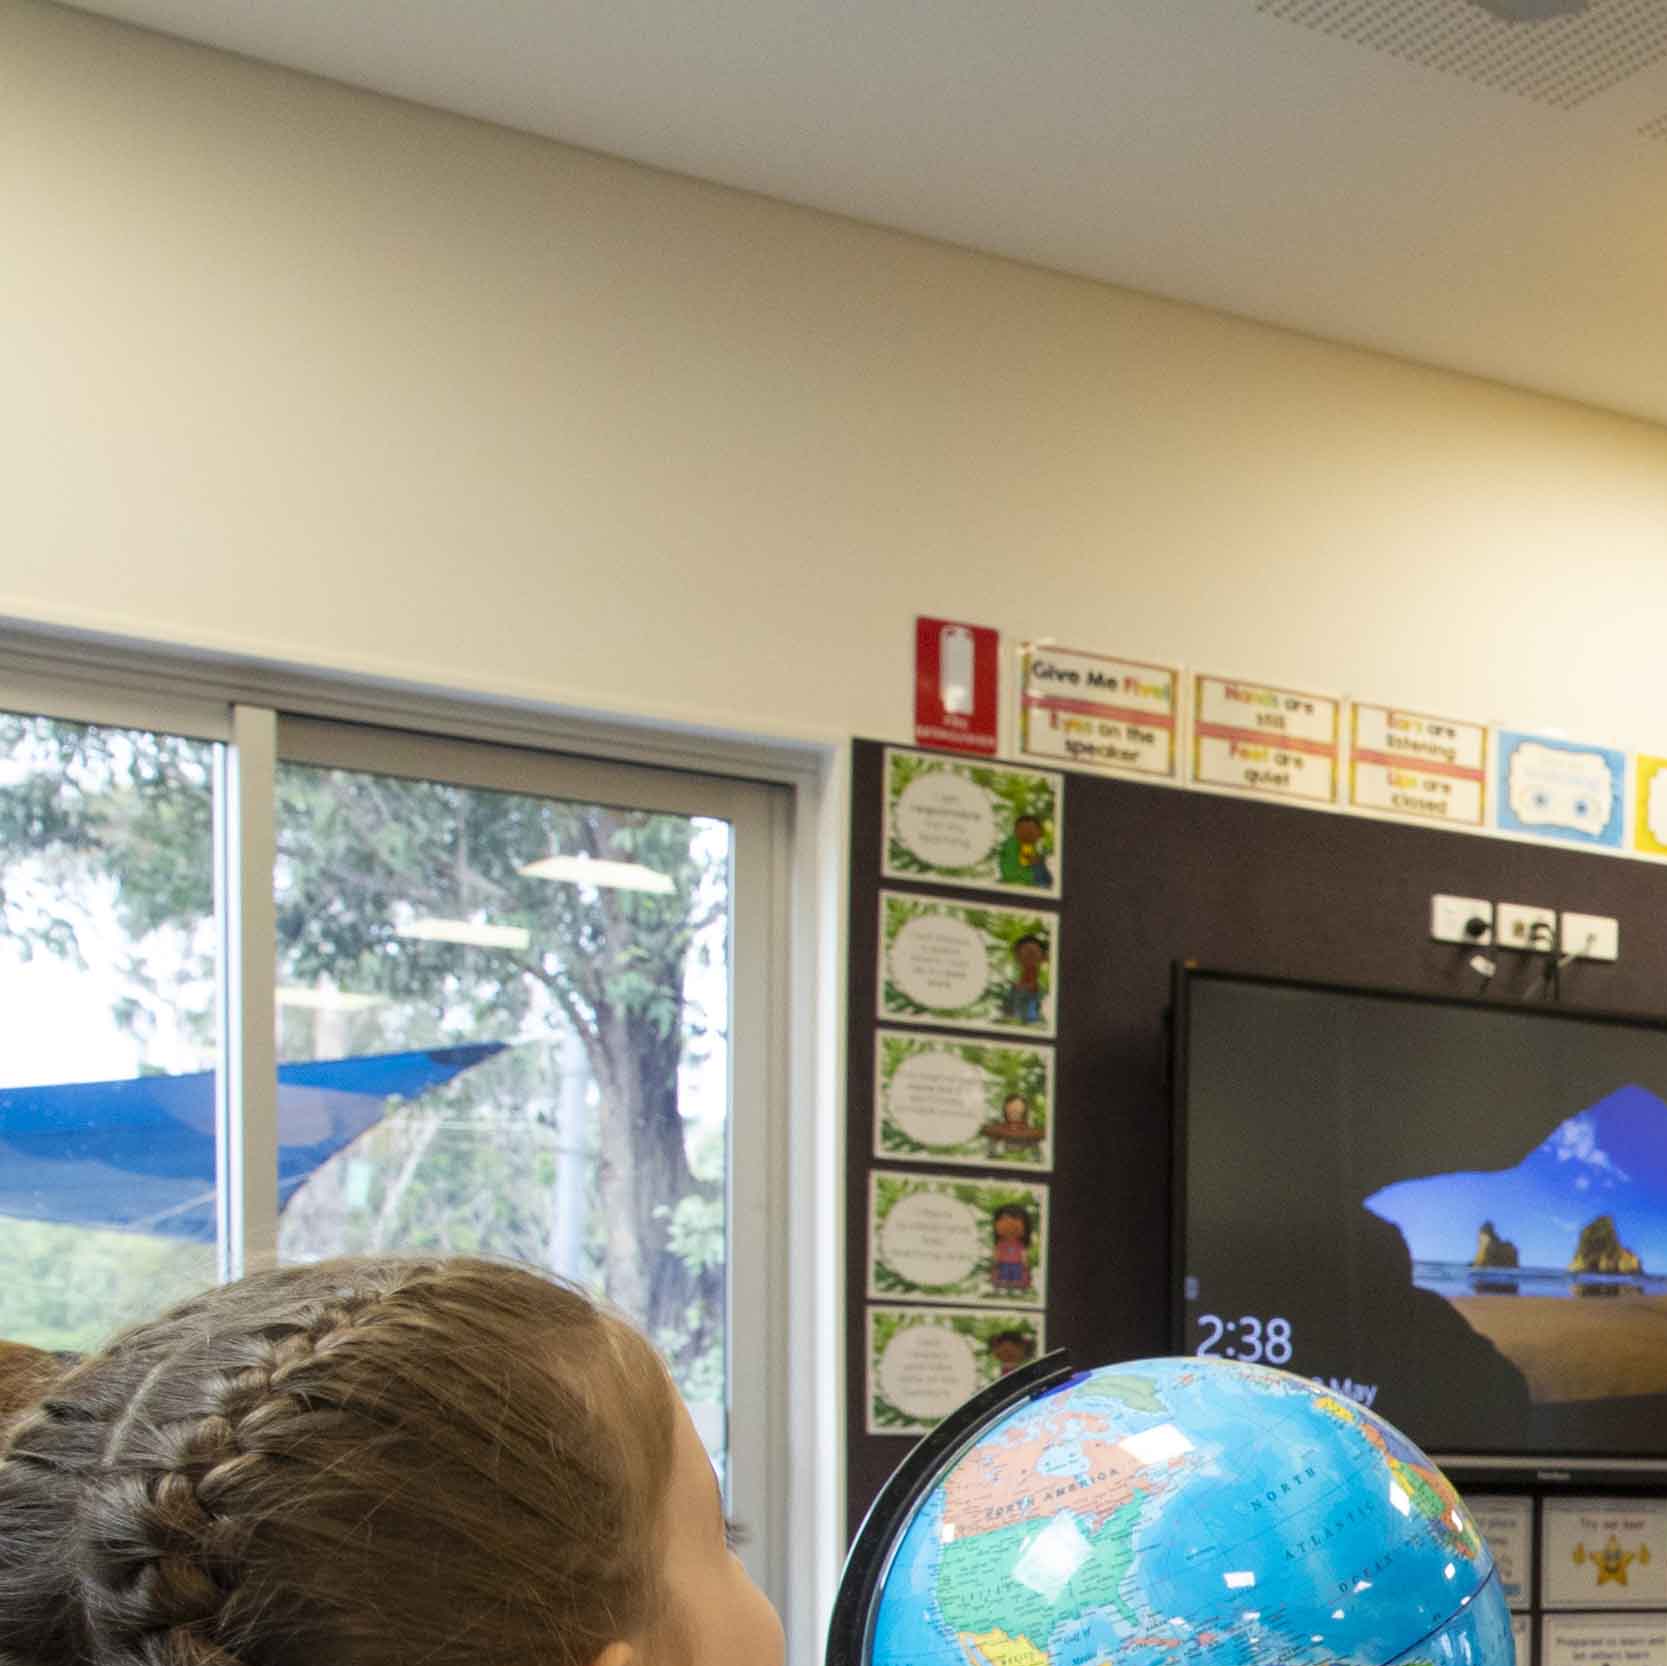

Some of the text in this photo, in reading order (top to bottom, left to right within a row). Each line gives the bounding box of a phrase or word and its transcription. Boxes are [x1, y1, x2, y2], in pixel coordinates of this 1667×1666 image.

[1032, 660, 1080, 685] Give
[1086, 671, 1118, 690] Me
[1284, 699, 1314, 714] are
[1098, 724, 1121, 738] on
[1126, 724, 1154, 744] the
[1064, 737, 1140, 763] speaker
[1196, 1314, 1293, 1364] 2:38
[1329, 1377, 1377, 1409] May
[1250, 1466, 1316, 1512] NORTH
